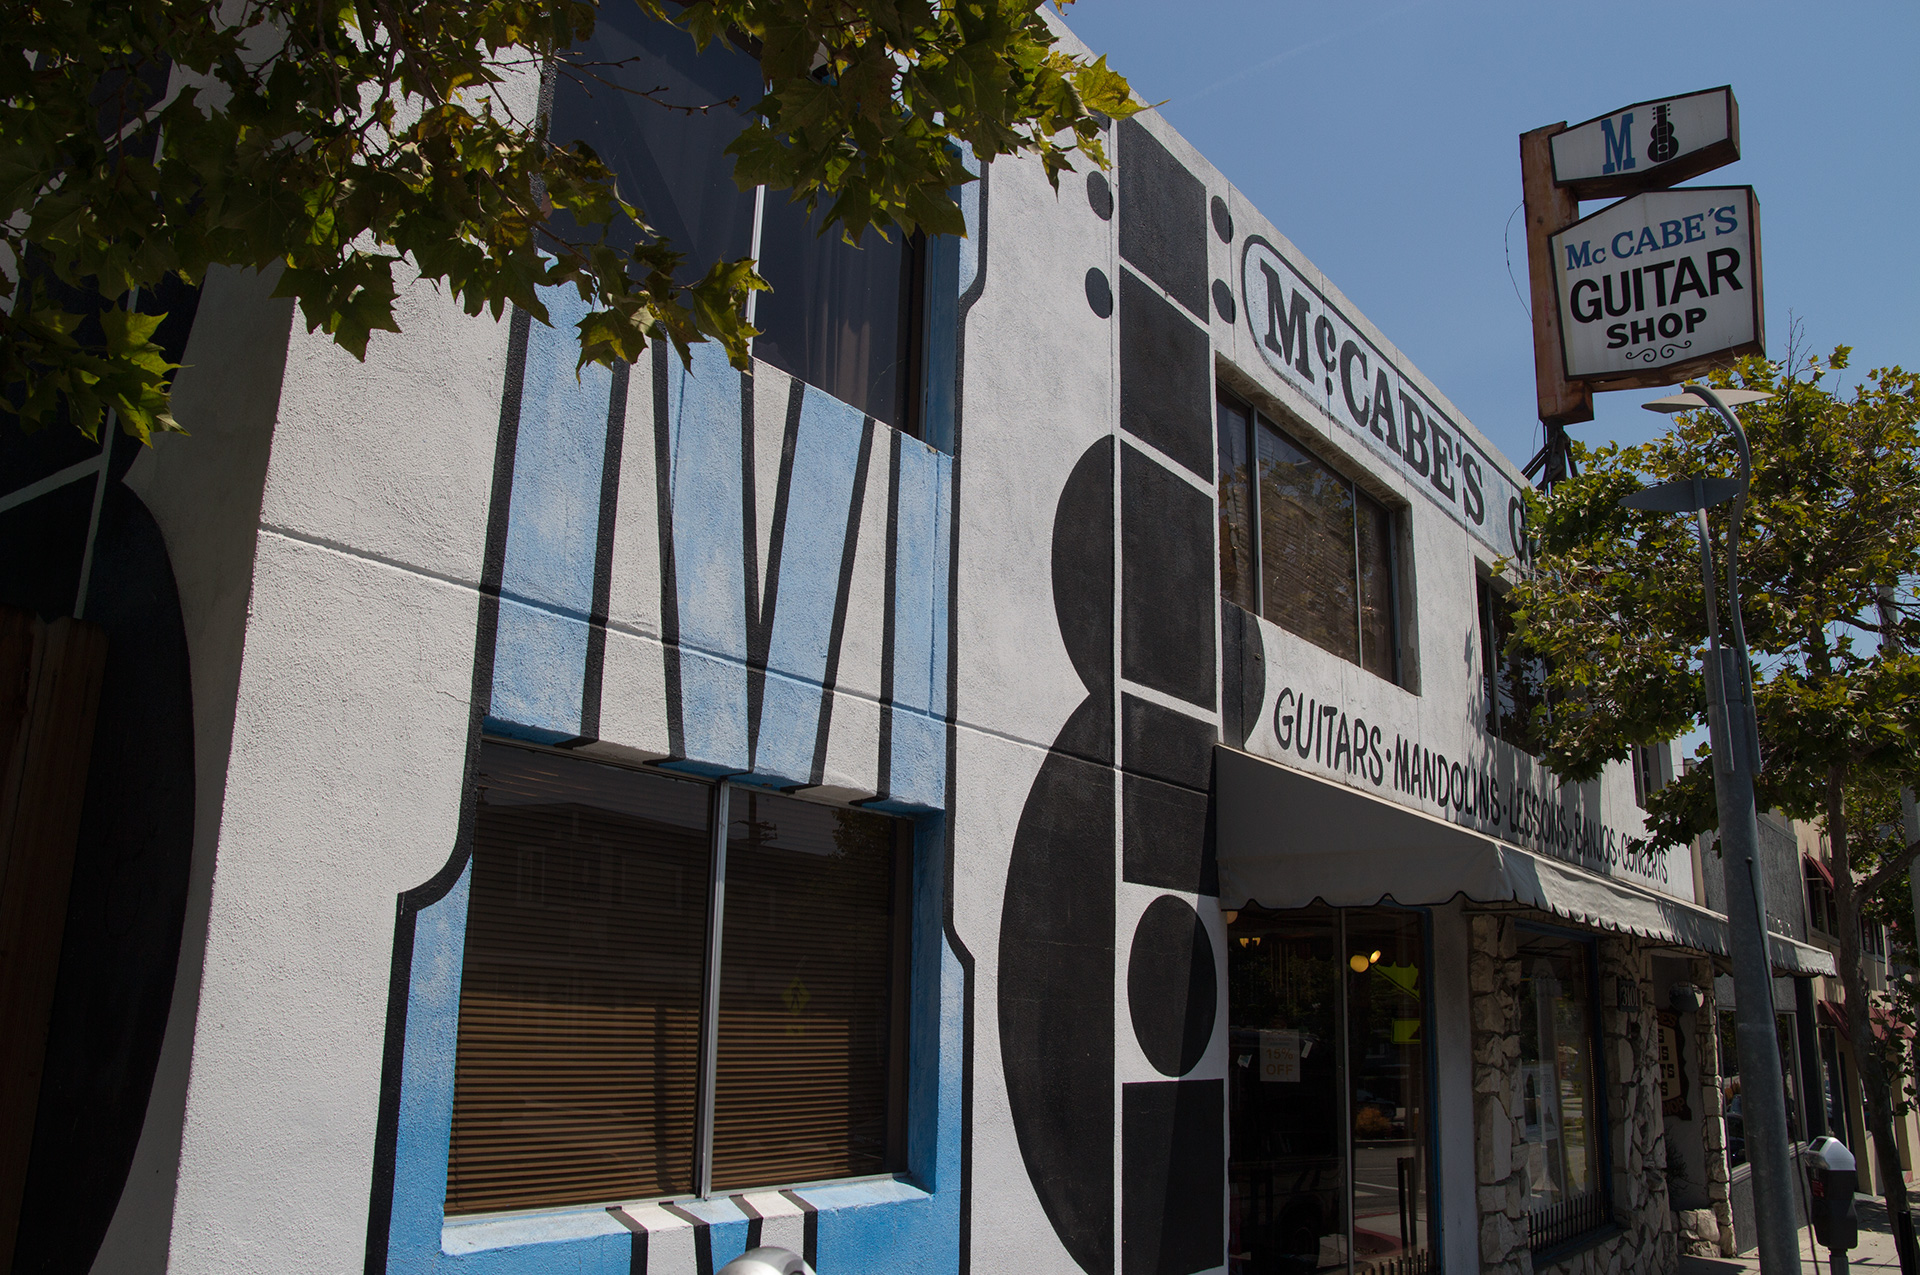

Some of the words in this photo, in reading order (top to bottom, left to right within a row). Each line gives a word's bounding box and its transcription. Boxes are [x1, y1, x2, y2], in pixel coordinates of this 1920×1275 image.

[1601, 113, 1636, 175] M
[1570, 247, 1744, 324] GUITAR
[1606, 307, 1707, 349] SHOP
[1274, 687, 1384, 786] GUITARS
[1394, 733, 1500, 826] MANDOLINS
[1509, 781, 1568, 850] LESSONS
[1575, 812, 1617, 867] BANJOS
[1622, 986, 1639, 1007] 3101
[1265, 1063, 1294, 1076] OFF
[1266, 1047, 1294, 1060] 15%
